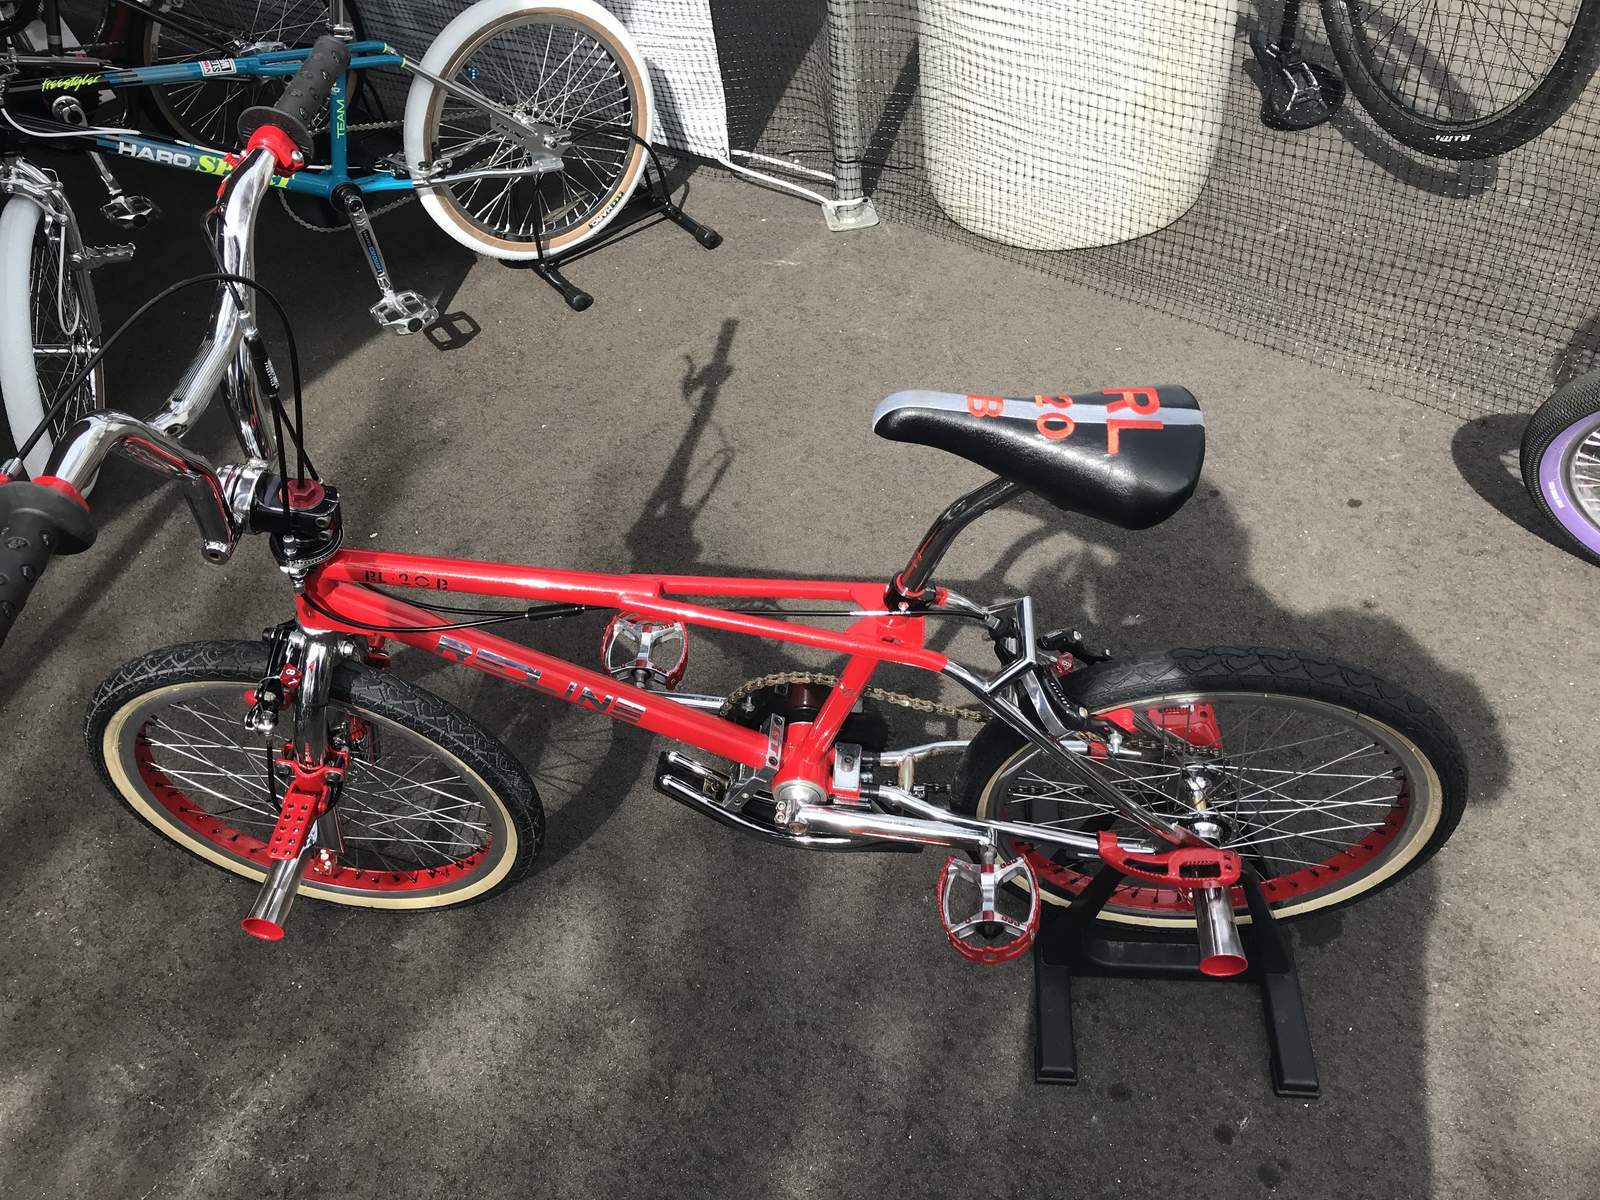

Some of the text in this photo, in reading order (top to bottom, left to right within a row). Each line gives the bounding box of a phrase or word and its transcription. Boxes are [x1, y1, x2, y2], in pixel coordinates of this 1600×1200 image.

[336, 99, 345, 139] TEAM
[118, 141, 294, 189] HARO SPT
[591, 204, 614, 226] HARO
[966, 394, 1005, 418] B
[1034, 394, 1075, 440] 20
[1103, 387, 1163, 455] RL
[437, 635, 647, 721] REDINE
